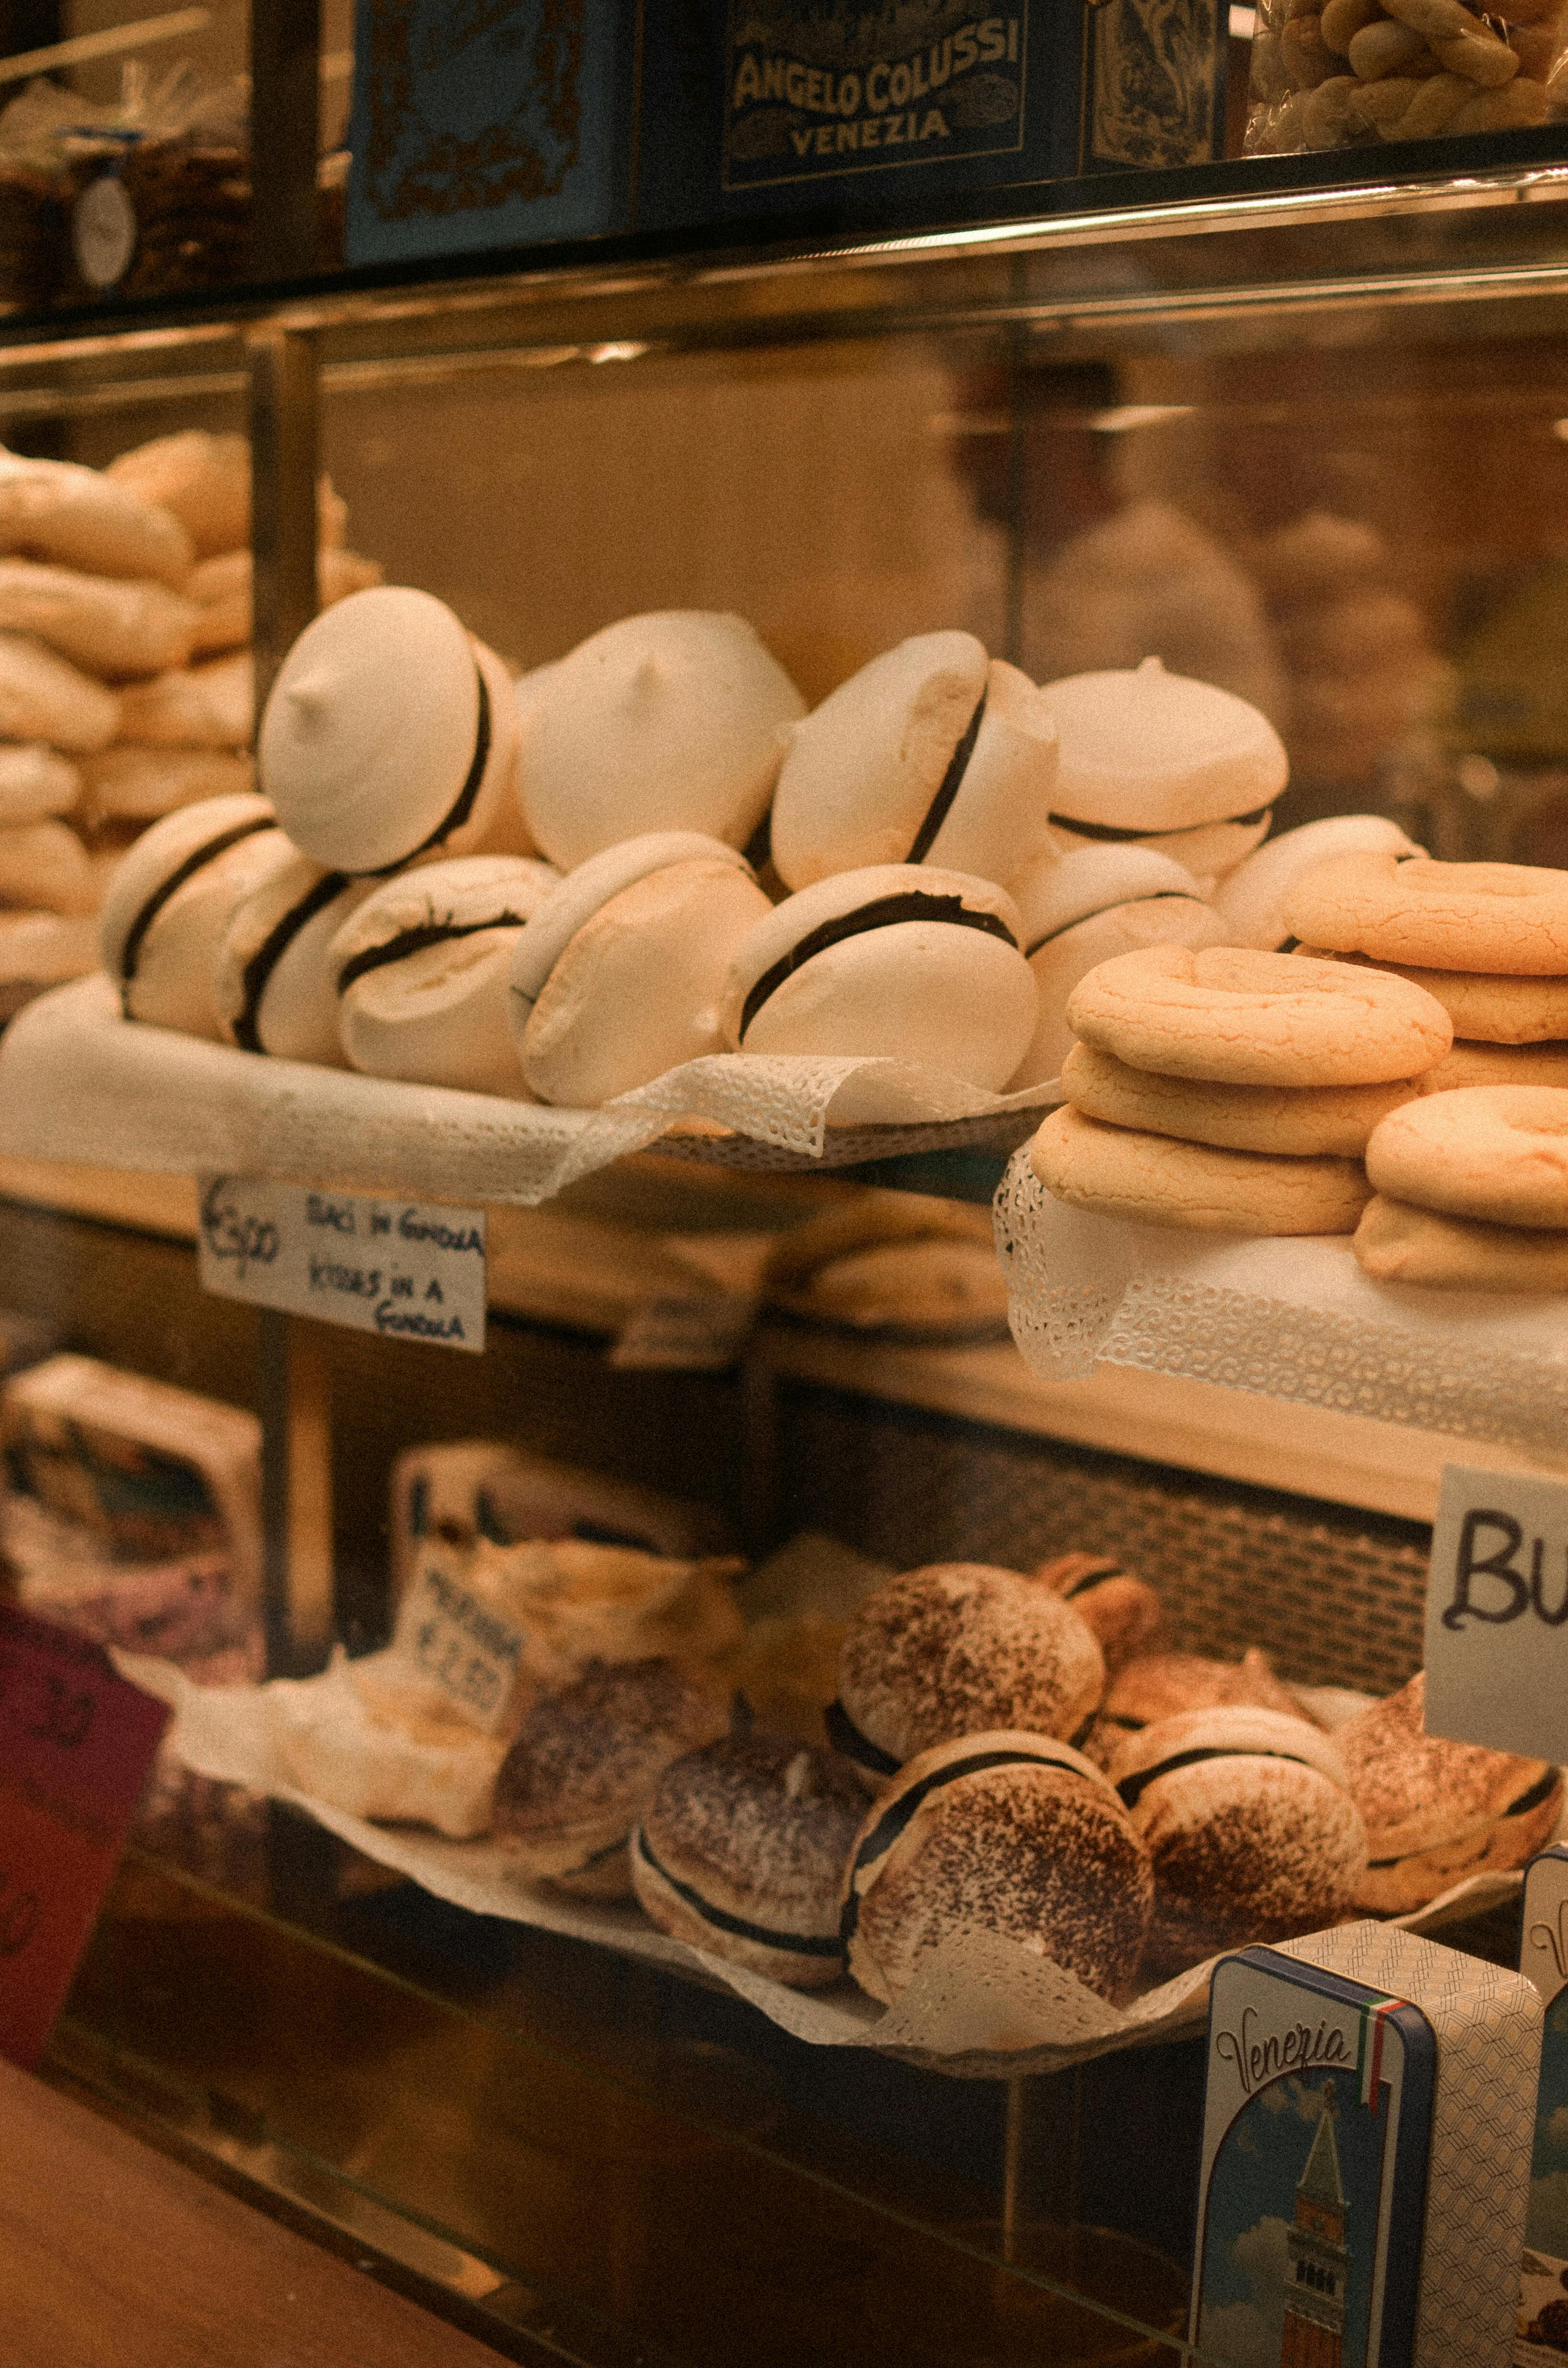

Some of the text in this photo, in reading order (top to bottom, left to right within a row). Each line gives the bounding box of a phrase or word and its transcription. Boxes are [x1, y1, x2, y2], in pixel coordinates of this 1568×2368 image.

[733, 18, 1019, 117] ANGELO COLUSSI
[791, 109, 951, 157] VENEZIA
[425, 1279, 444, 1304] A
[1216, 2006, 1352, 2093] Venezia
